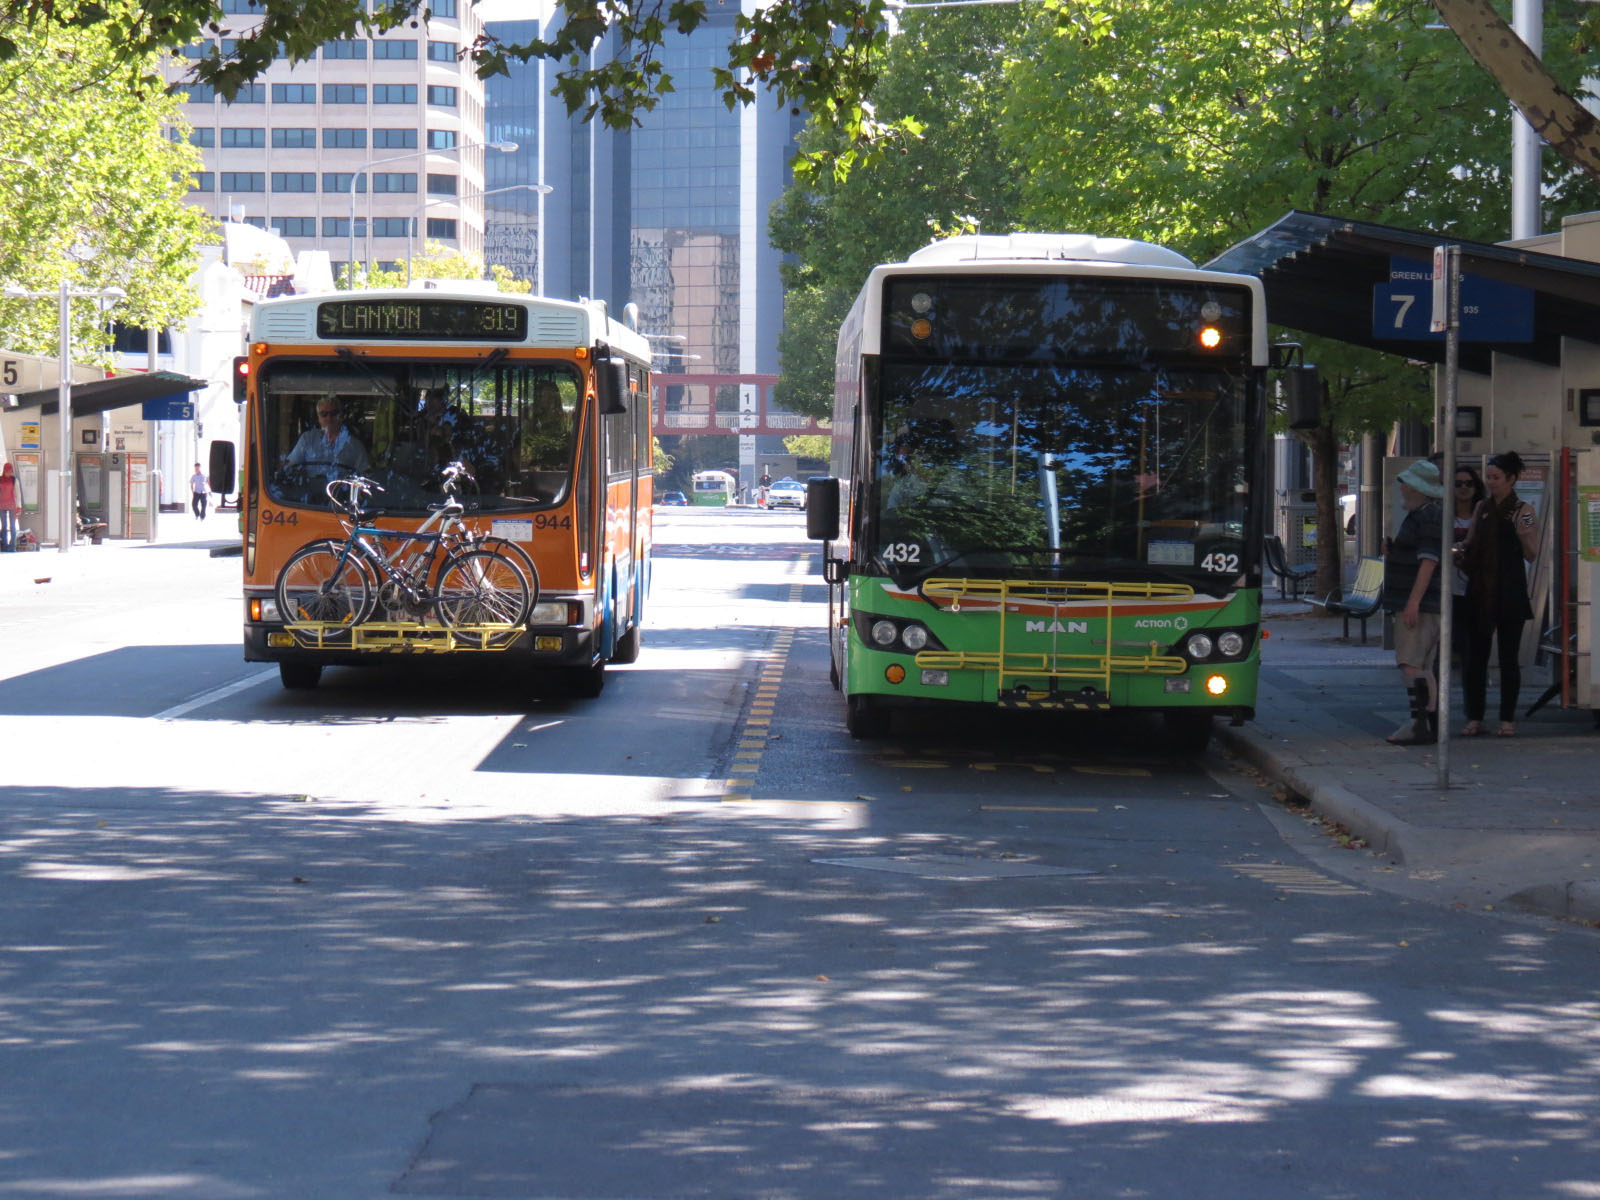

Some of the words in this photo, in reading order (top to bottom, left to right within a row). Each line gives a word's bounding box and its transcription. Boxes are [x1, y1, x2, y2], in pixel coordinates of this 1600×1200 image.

[1391, 271, 1422, 280] GREEN
[1424, 272, 1433, 281] LI
[342, 304, 420, 329] LANYON
[481, 307, 517, 331] 319
[1391, 294, 1415, 328] 7
[1463, 306, 1479, 314] 935
[4, 360, 17, 385] 5
[182, 406, 190, 418] 5
[112, 453, 119, 465] 5
[261, 509, 298, 526] 944
[534, 513, 571, 531] 944
[882, 543, 920, 563] 432
[1201, 553, 1239, 573] 432
[1025, 620, 1088, 634] MAN
